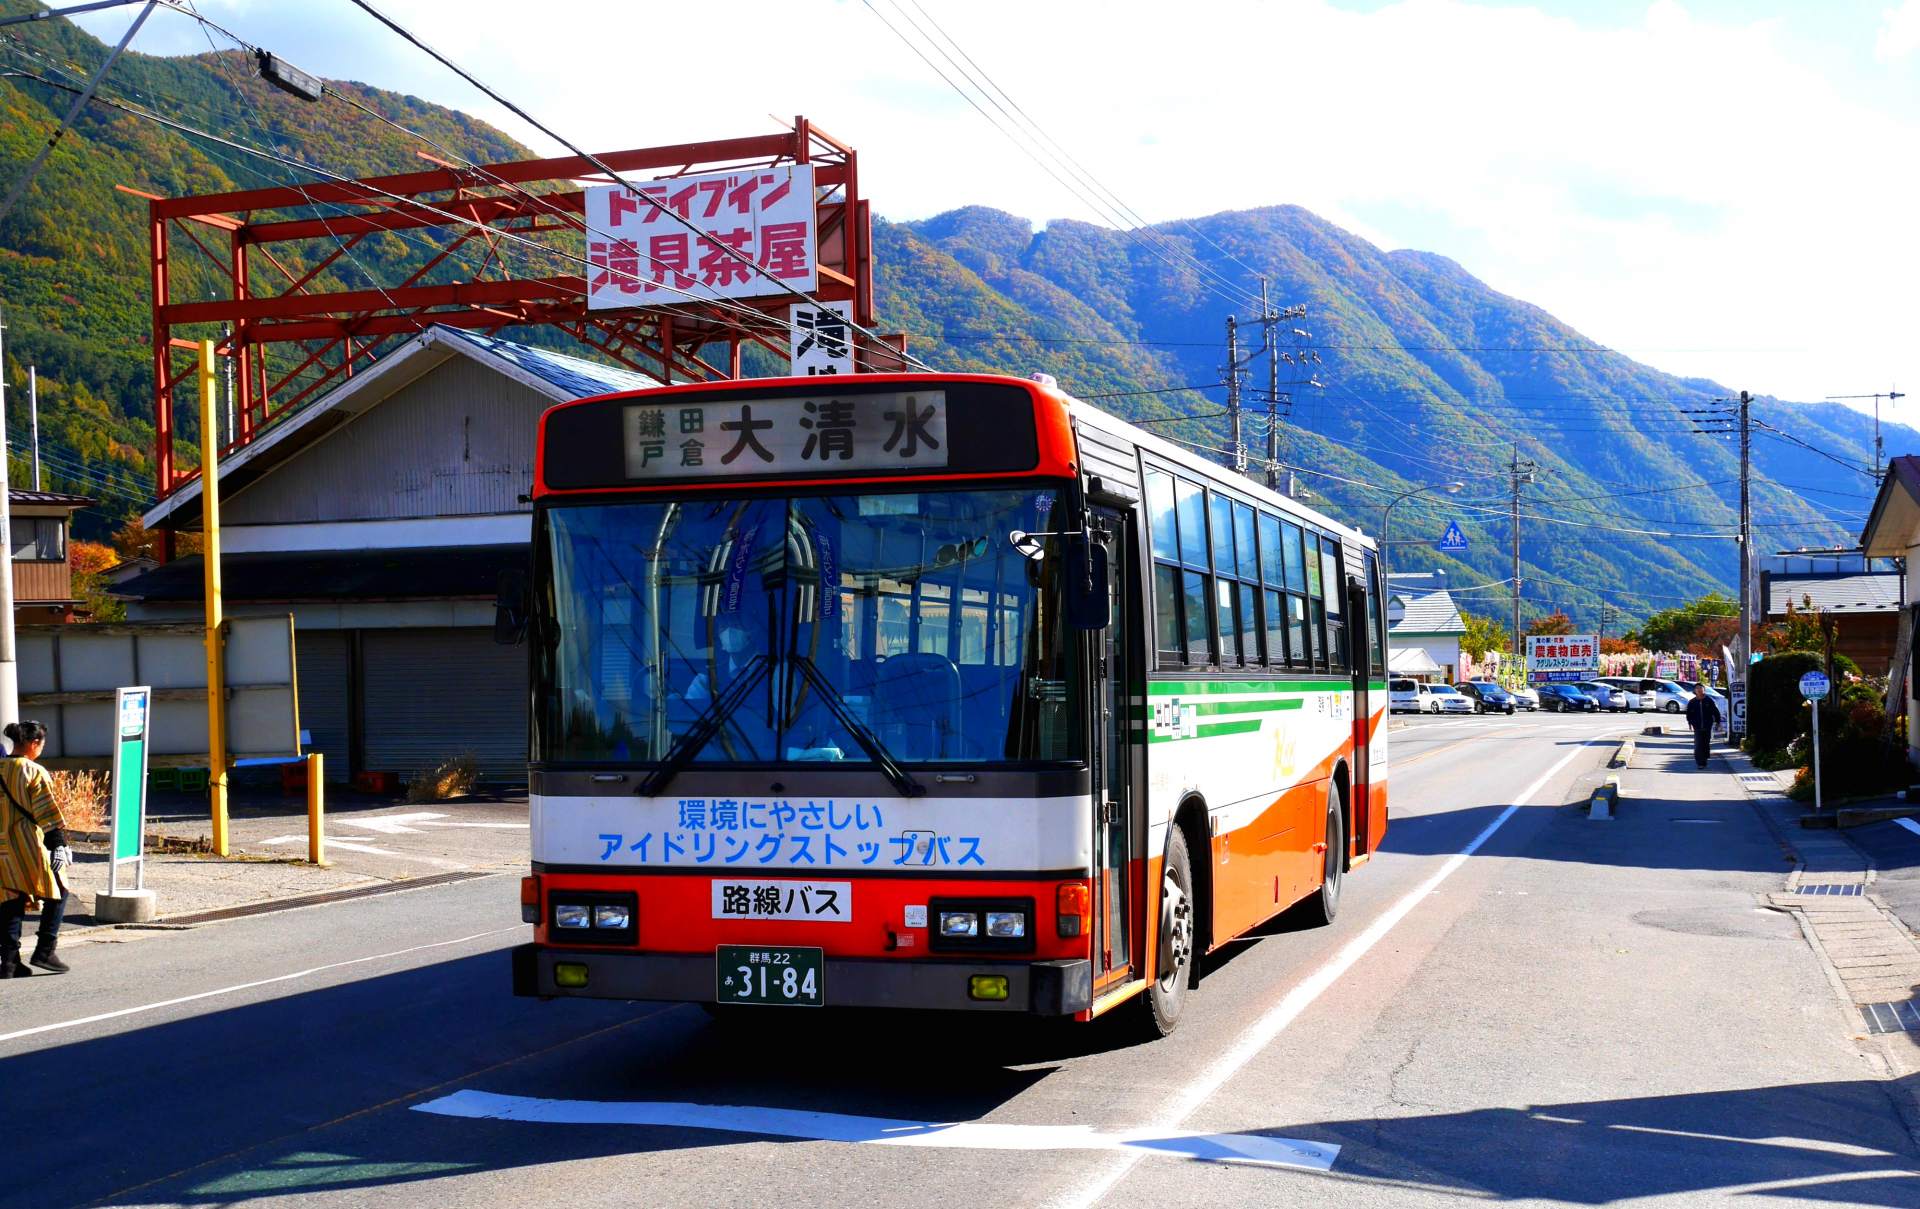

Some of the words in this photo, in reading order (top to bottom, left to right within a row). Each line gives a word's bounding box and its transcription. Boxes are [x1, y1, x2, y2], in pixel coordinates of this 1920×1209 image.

[608, 174, 792, 226] ドライブイン
[590, 222, 810, 296] 滝見茶屋
[796, 309, 849, 376] 滝
[638, 408, 704, 437] 鎌田
[720, 396, 941, 465] 大清水
[639, 438, 705, 469] 戸倉
[1535, 645, 1592, 658] 農産物直売
[678, 799, 884, 831] 環境にやさしい
[598, 831, 986, 867] アイドリングストップバス
[721, 884, 842, 917] 路線バス
[737, 965, 817, 999] 31-84
